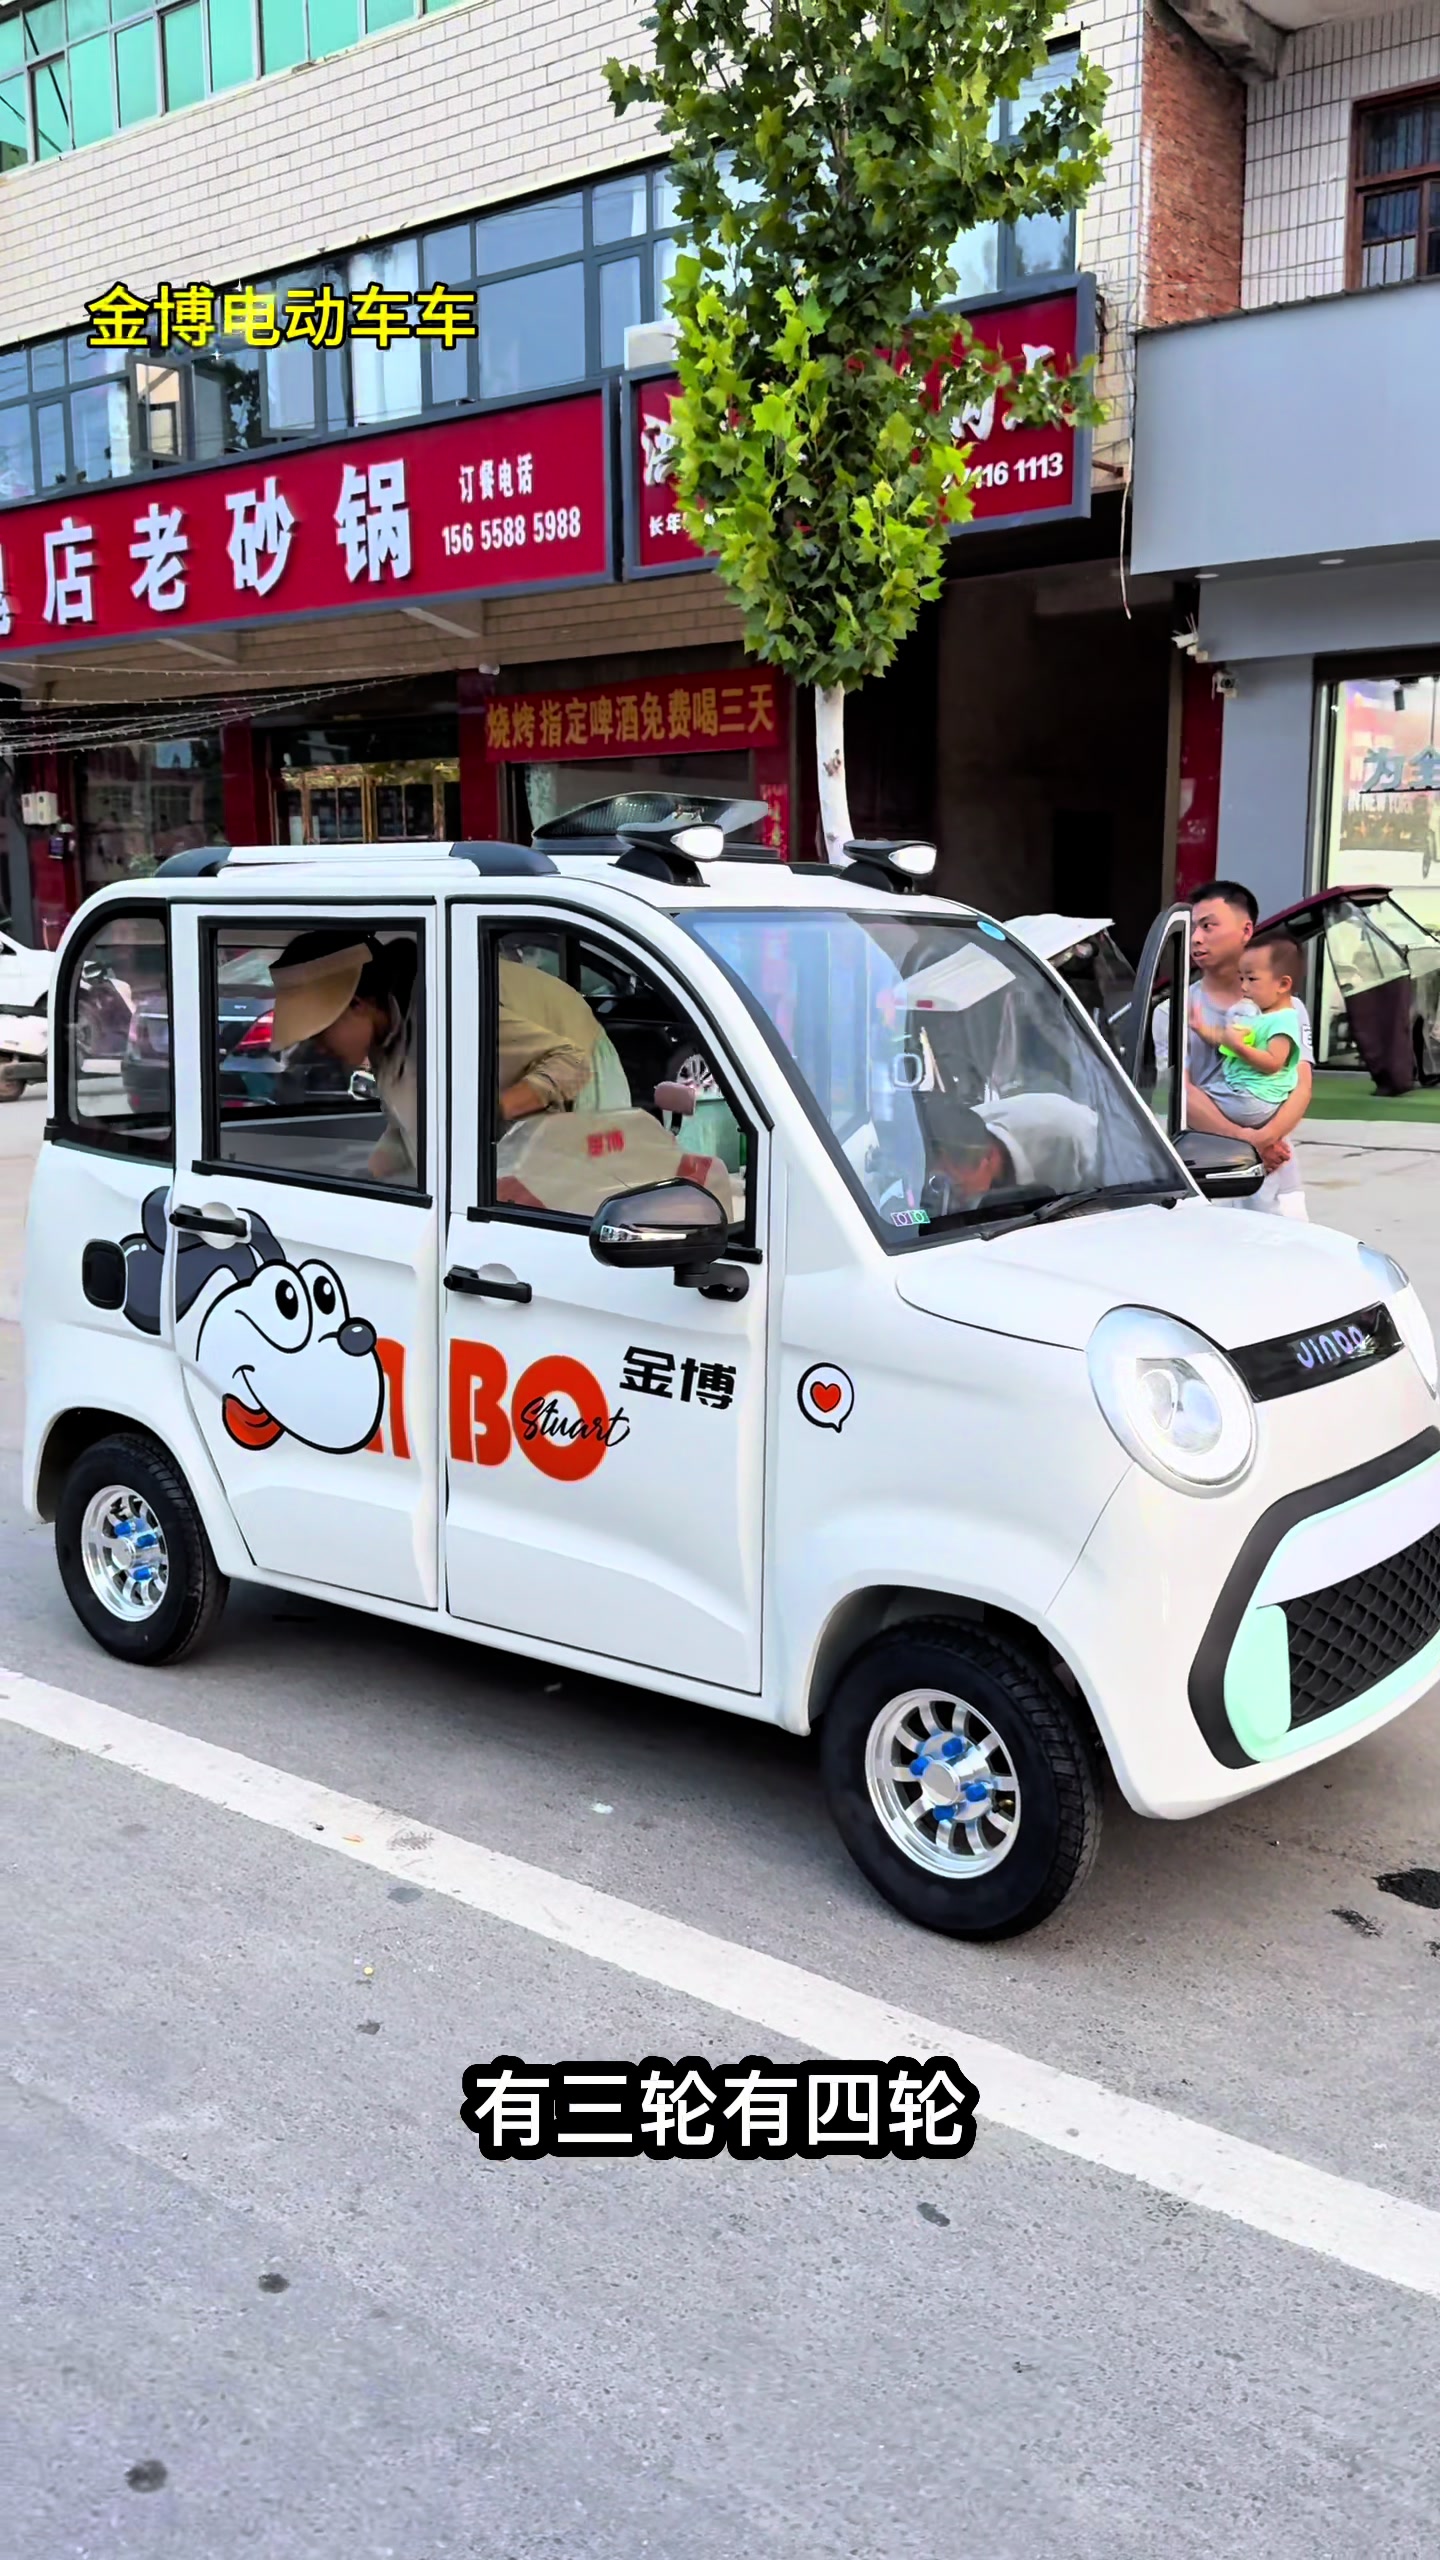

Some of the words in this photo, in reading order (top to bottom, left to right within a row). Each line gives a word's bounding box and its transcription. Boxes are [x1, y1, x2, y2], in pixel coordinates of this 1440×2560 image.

[459, 452, 532, 503] 订餐电话
[1013, 452, 1063, 482] 1113
[0, 458, 411, 635] 店老砂锅
[442, 522, 473, 556] 156
[480, 514, 526, 550] 5588
[533, 505, 581, 544] 5988
[619, 1346, 737, 1410] 金博
[520, 1396, 631, 1447] Stuart
